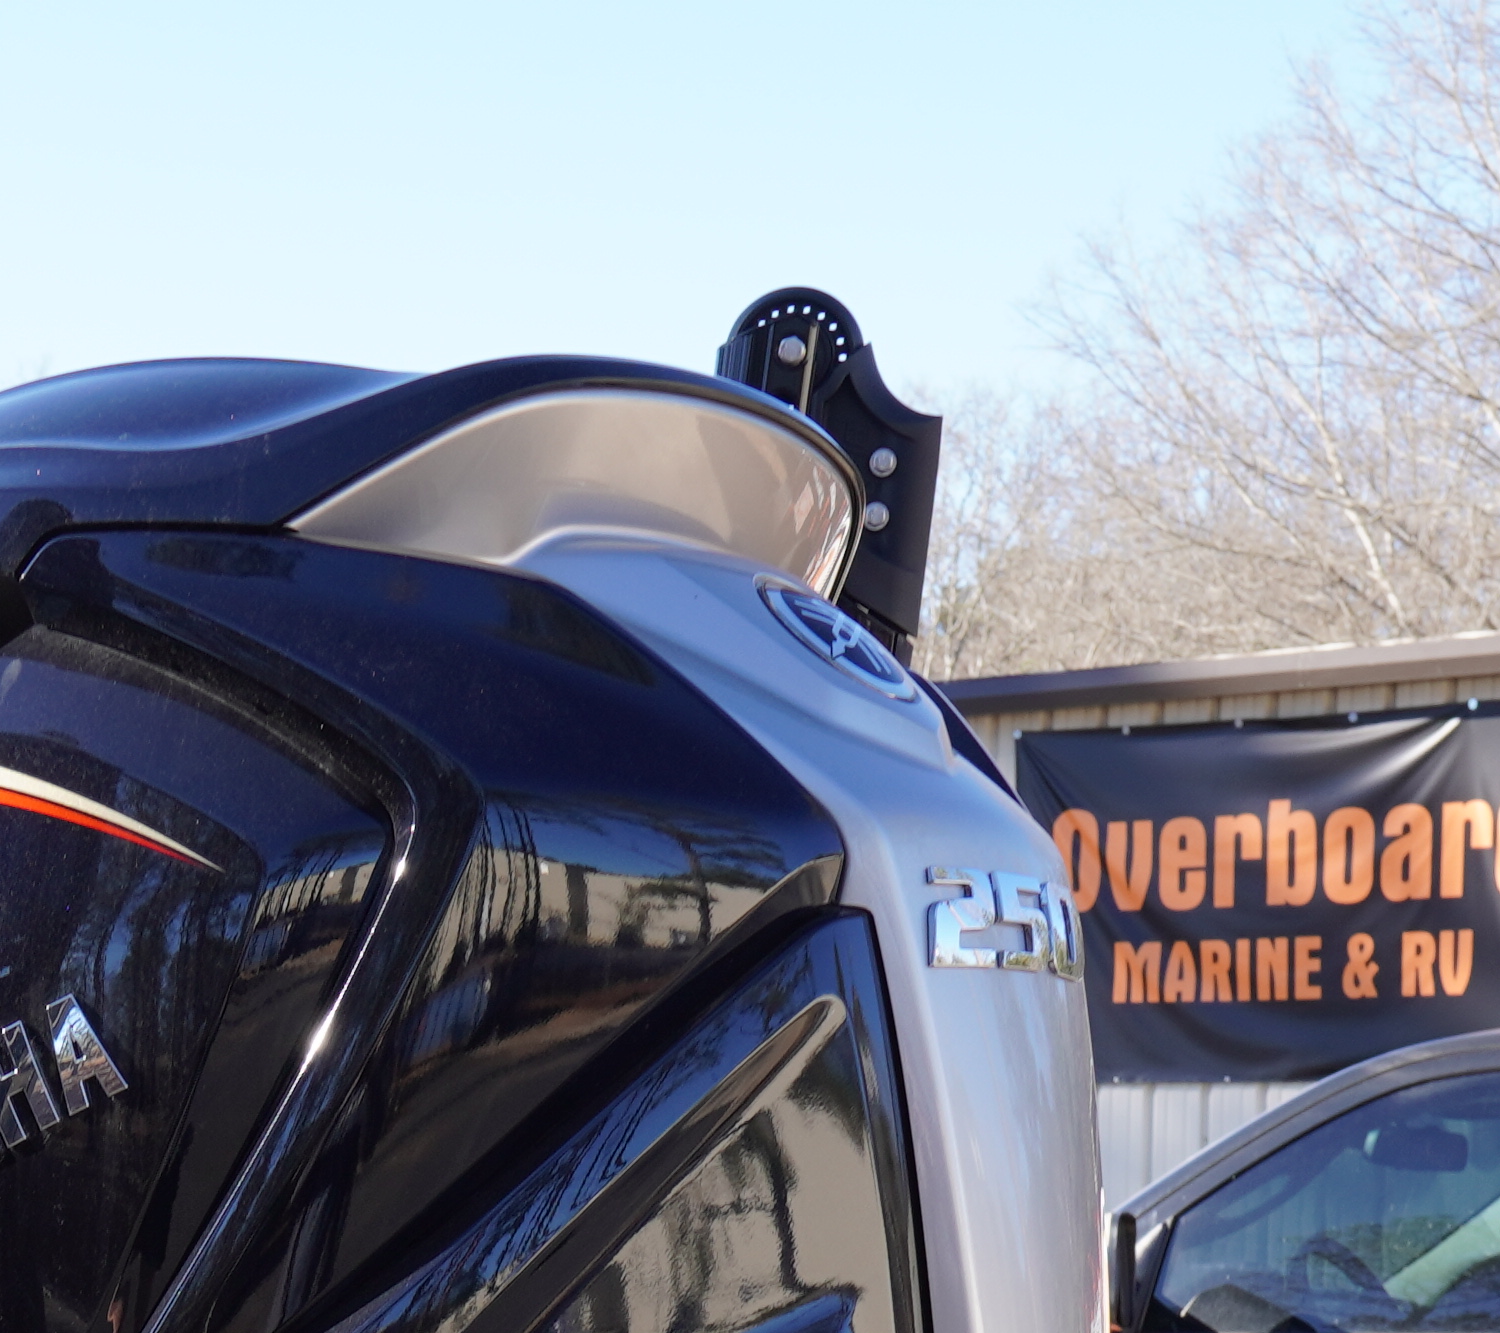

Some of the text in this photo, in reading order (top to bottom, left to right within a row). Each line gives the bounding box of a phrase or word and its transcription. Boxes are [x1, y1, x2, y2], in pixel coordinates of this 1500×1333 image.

[925, 865, 1085, 982] 250
[1112, 929, 1474, 1005] MARINE & RV
